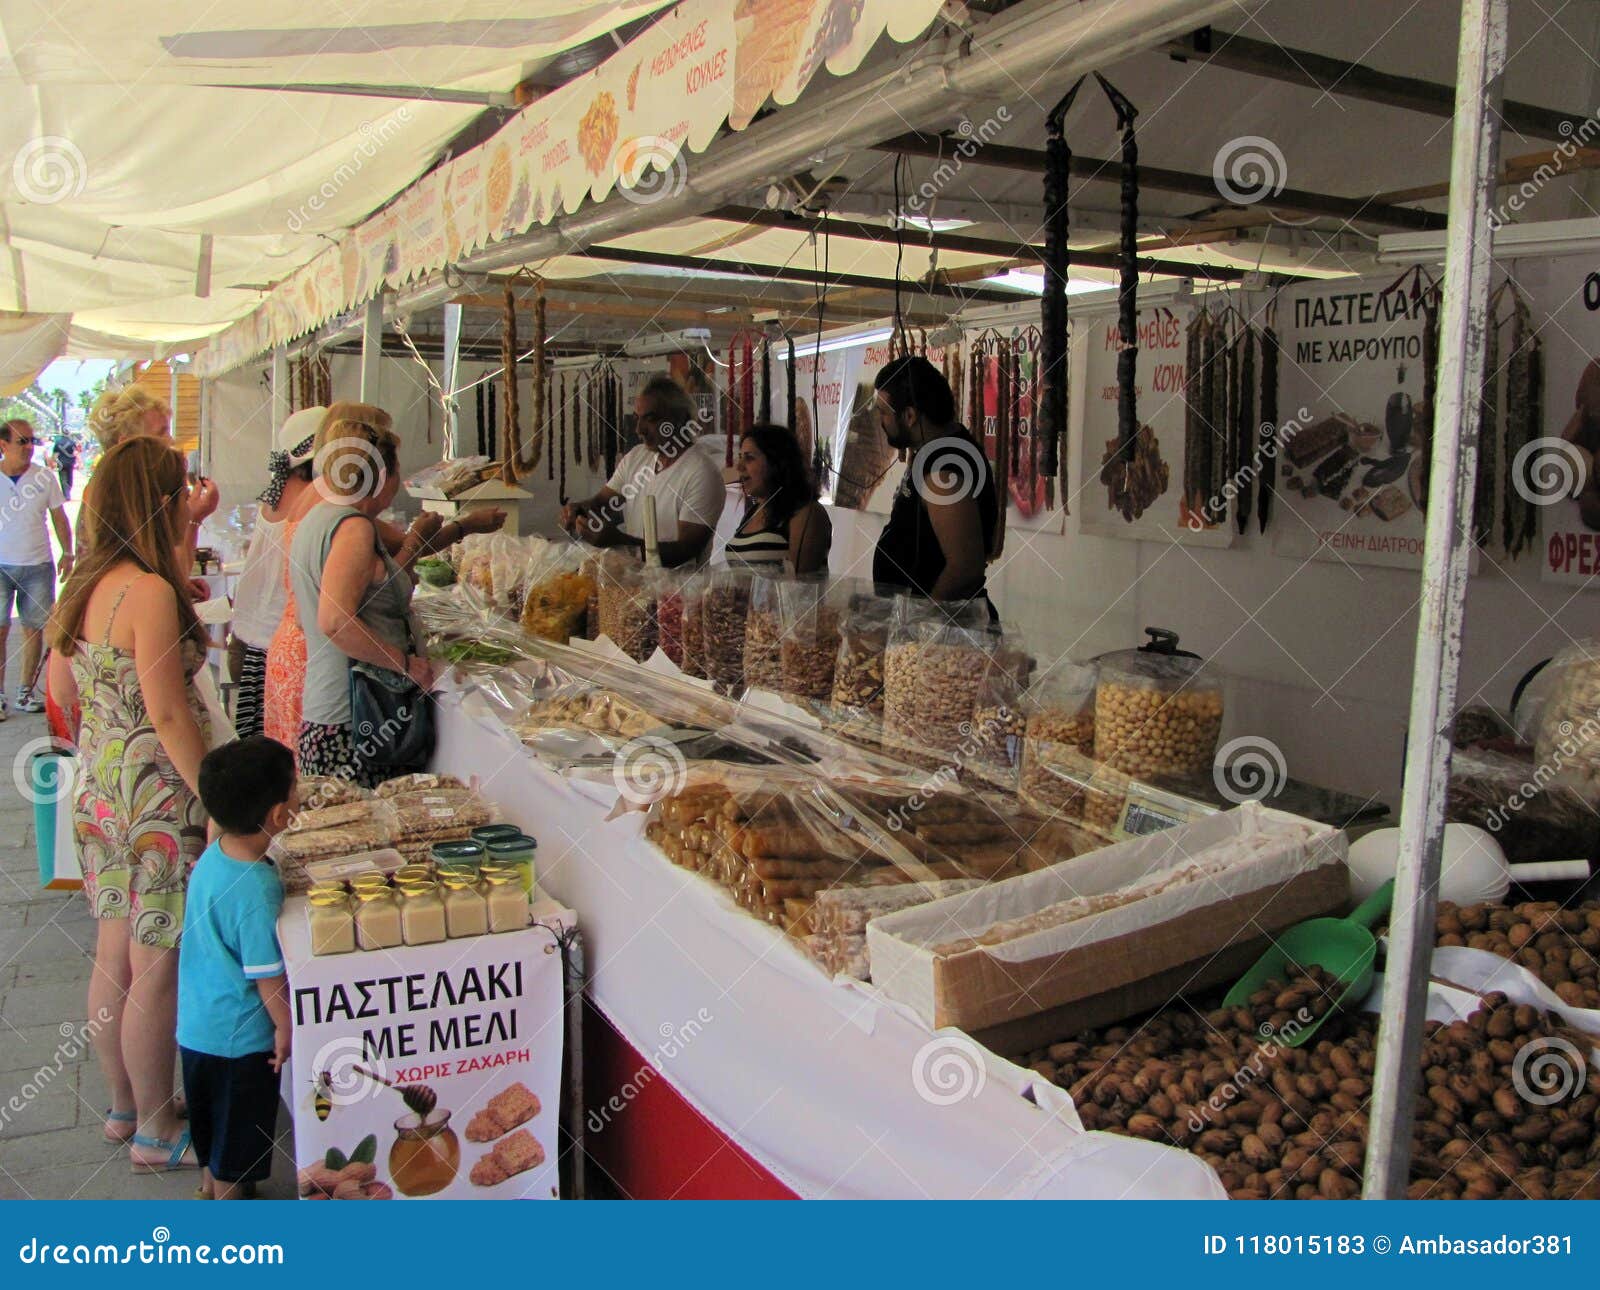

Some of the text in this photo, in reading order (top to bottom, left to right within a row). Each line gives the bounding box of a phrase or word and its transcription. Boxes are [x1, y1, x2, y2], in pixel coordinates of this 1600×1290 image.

[1295, 288, 1429, 328] ΠΑΣΤΕΛΑΚ
[1105, 318, 1180, 352] ΜΕΜΕΝΕΣ
[1297, 341, 1322, 364] ΜΕ
[1152, 363, 1187, 393] ΚΟΥΝ
[294, 961, 523, 1026] ΠΑΣΤΕΛΑΚΙ
[362, 1009, 518, 1062] ΜΕ ΜΕΛΙ
[395, 1049, 531, 1084] ΧΩΡΙΣ ΖΑΧΑΡΗ
